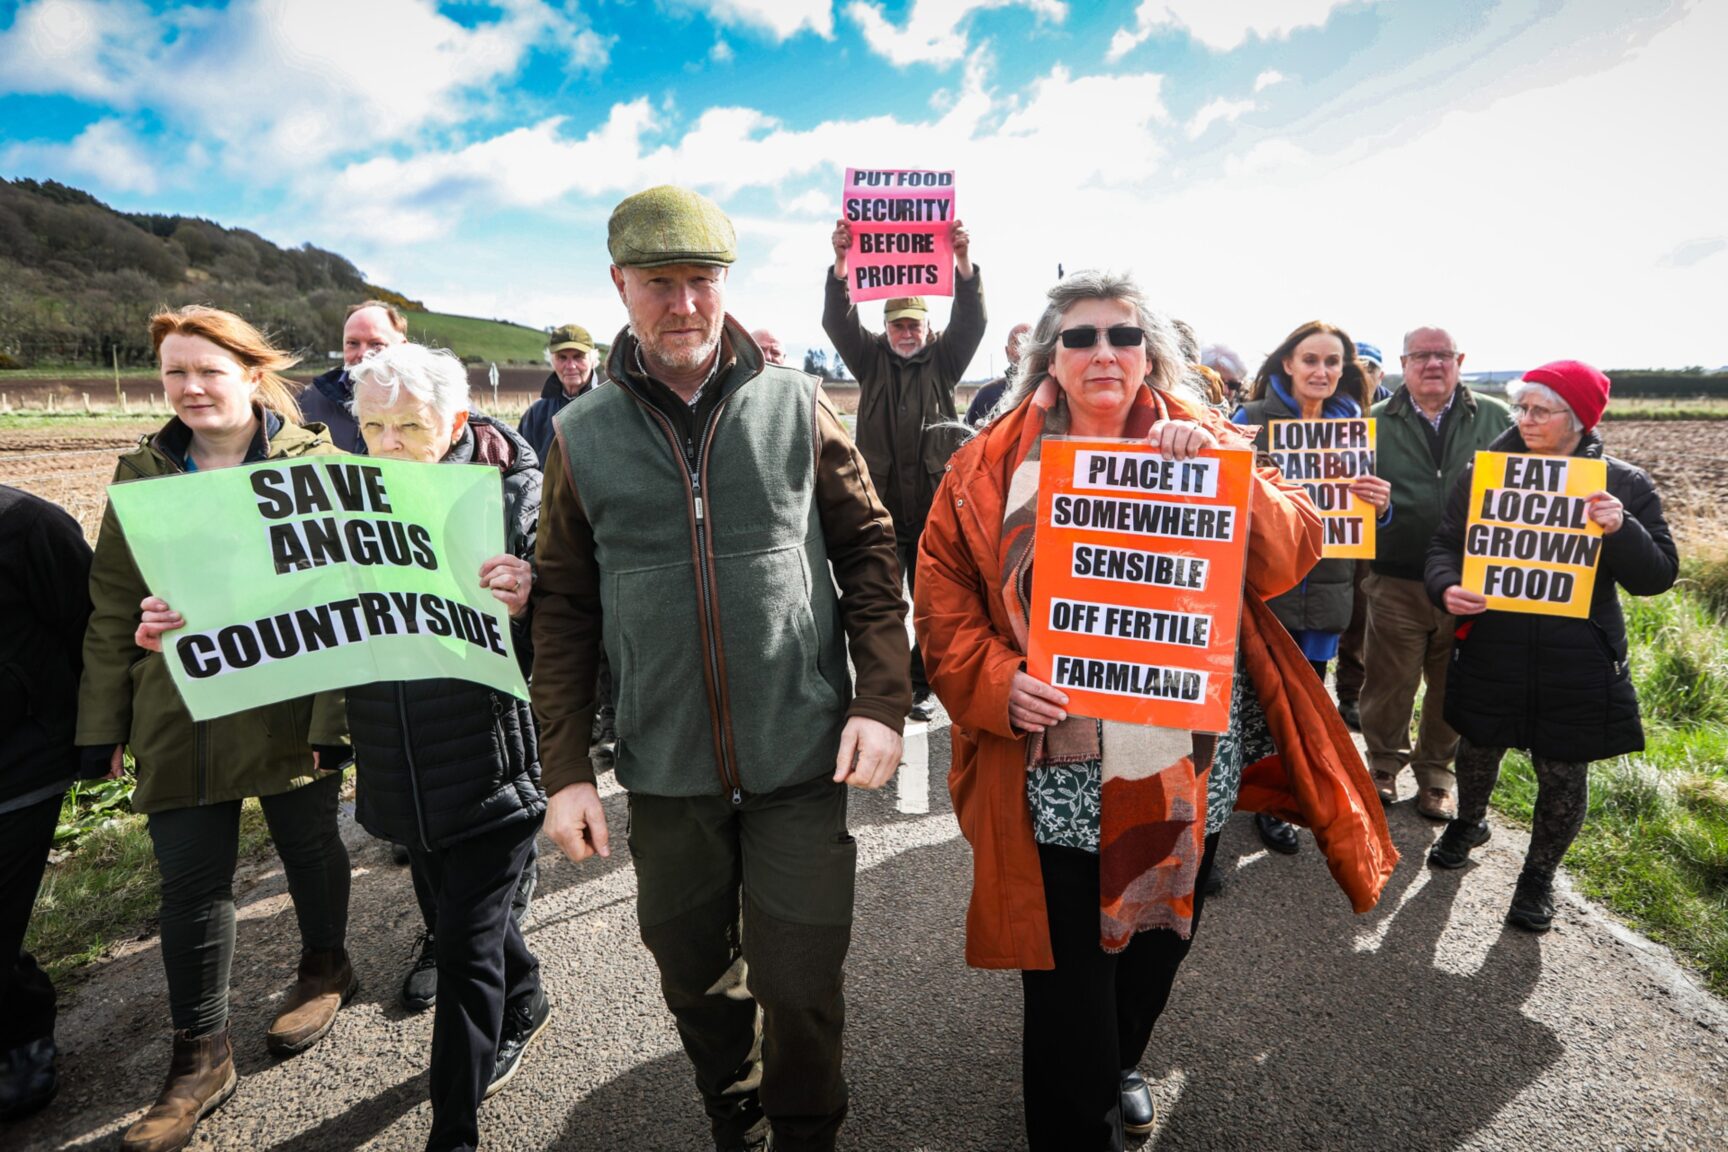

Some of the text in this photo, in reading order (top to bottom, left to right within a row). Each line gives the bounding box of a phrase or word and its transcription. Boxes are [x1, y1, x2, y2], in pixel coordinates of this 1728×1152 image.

[853, 171, 952, 186] PUT FOOD
[847, 198, 950, 222] SECURITY
[859, 233, 934, 254] BEFORE
[856, 264, 938, 289] PROFITS
[1273, 421, 1367, 450] LOWER
[250, 464, 392, 519] SAVE
[1089, 455, 1209, 493] PLACE IT
[1504, 456, 1566, 492] EAT
[1293, 483, 1350, 510] OOT
[1480, 489, 1586, 530] LOCAL
[1054, 496, 1231, 540] SOMEWHERE
[268, 516, 438, 575] ANGUS
[1467, 523, 1602, 568] GROWN
[1074, 546, 1204, 588] SENSIBLE
[1484, 564, 1574, 603] FOOD
[176, 592, 508, 679] COUNTRYSIDE
[1052, 601, 1209, 647] OFF FERTILE
[1055, 656, 1202, 701] FARMLAND
